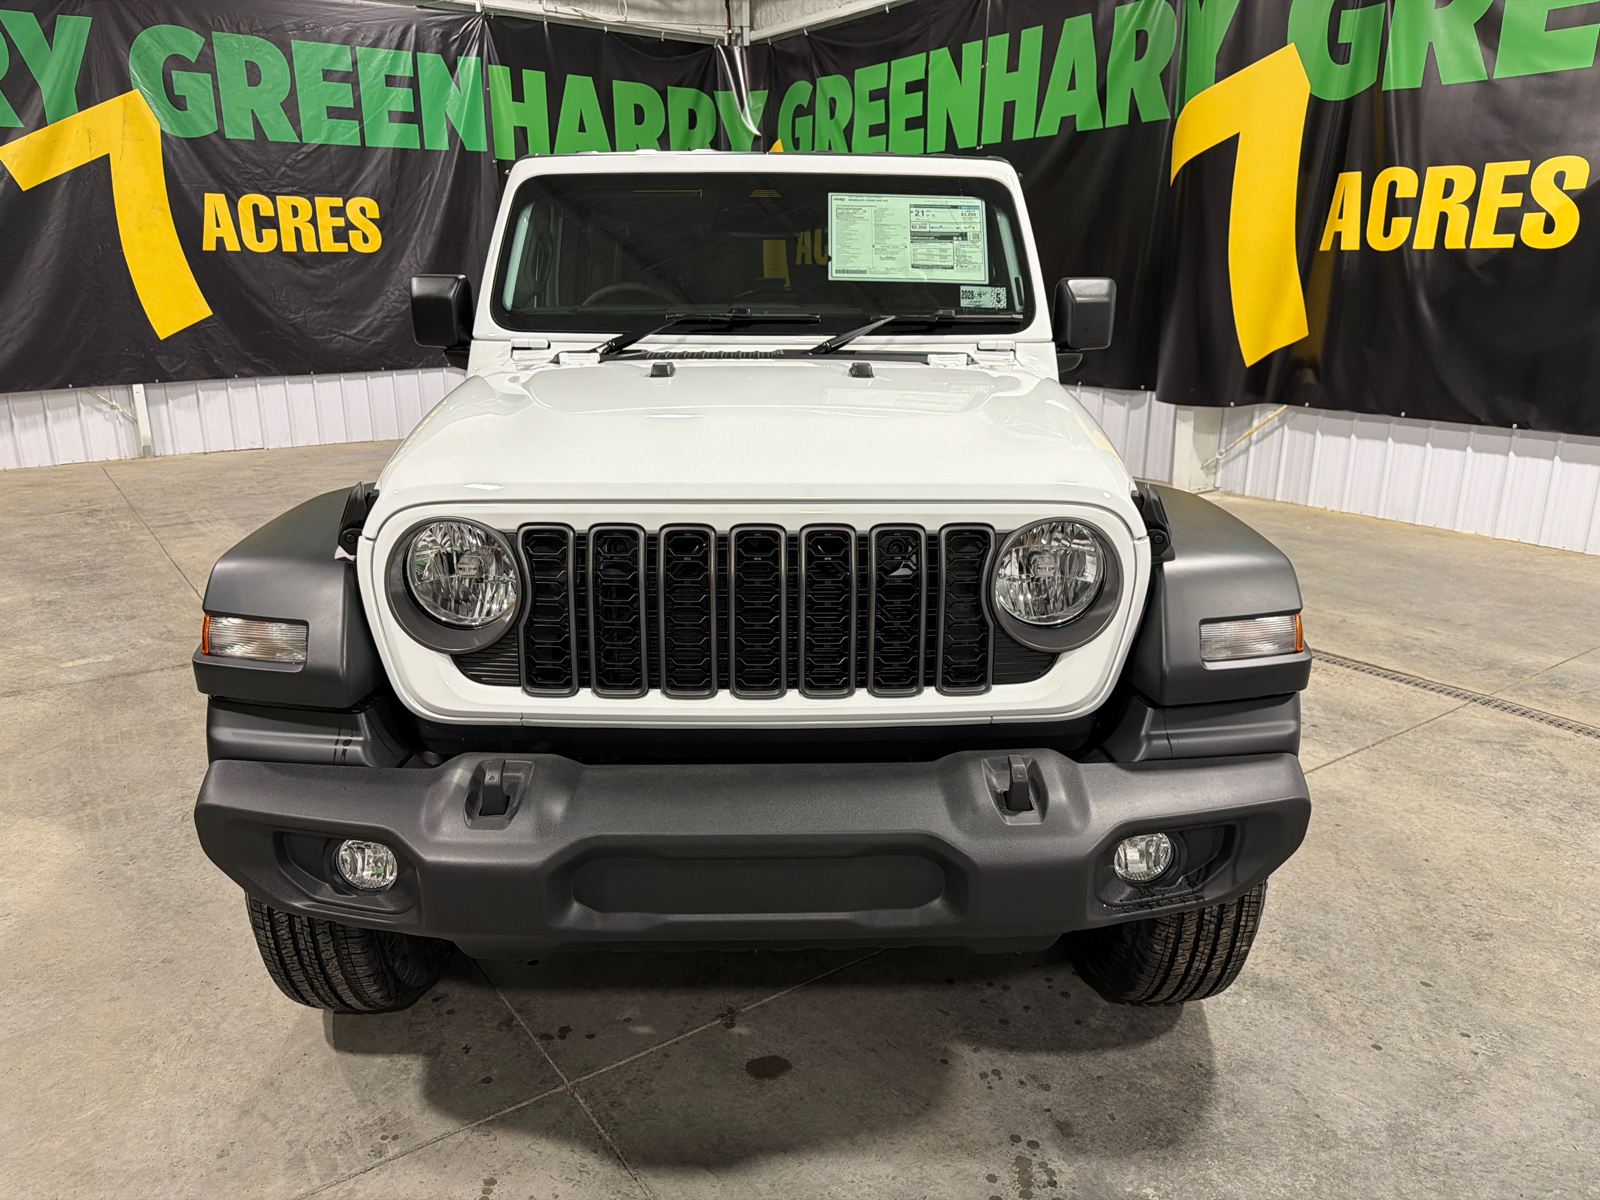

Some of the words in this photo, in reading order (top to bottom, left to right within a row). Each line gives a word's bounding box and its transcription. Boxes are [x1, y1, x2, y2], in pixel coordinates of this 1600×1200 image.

[129, 24, 488, 152] GREEN
[488, 64, 769, 160] HARRY
[778, 40, 983, 155] GREEN
[0, 89, 213, 340] 7
[203, 193, 382, 253] ACRES
[1170, 42, 1311, 367] 7
[1319, 155, 1590, 252] ACRES
